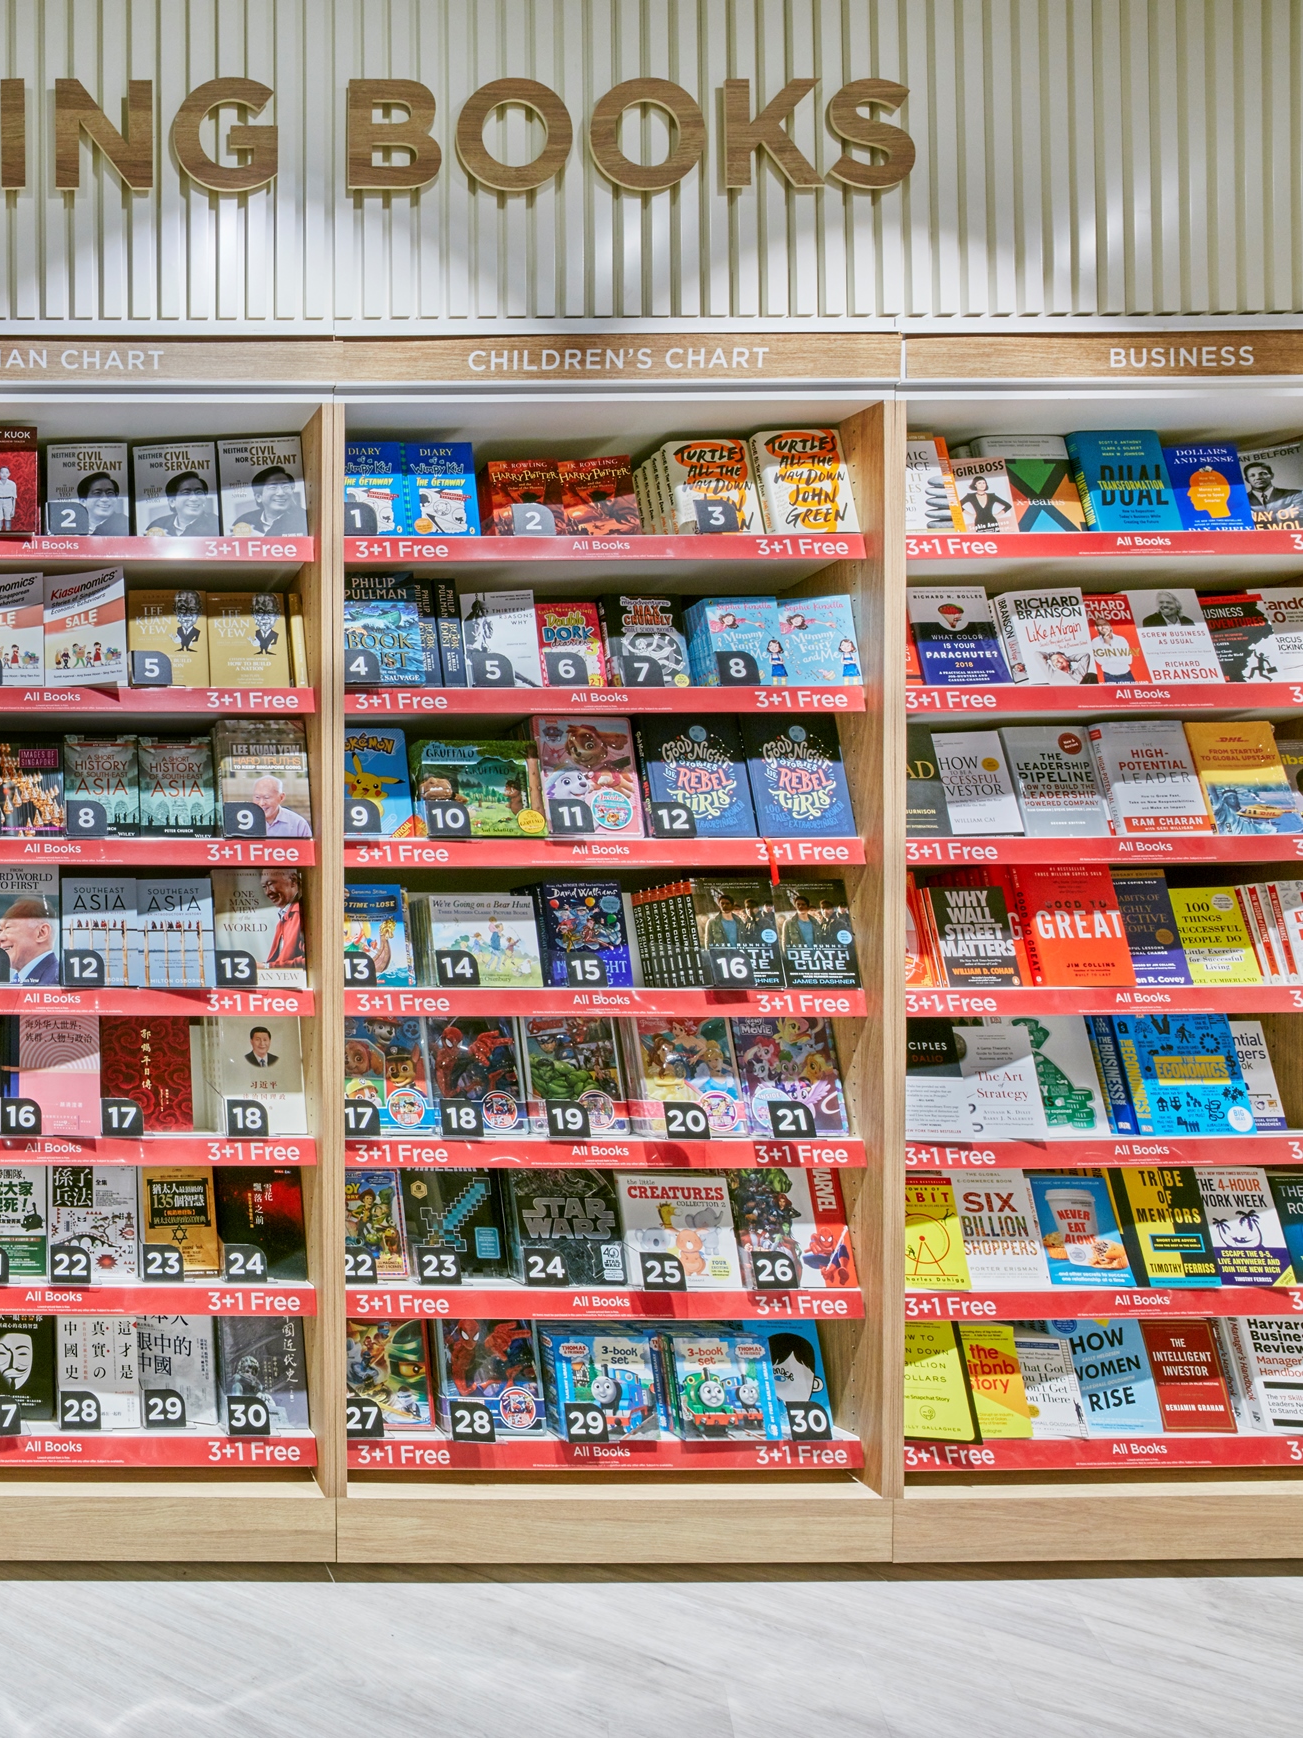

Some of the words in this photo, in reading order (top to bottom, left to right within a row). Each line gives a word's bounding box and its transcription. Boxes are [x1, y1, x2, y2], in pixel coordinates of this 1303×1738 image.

[347, 77, 916, 190] BOOKS
[61, 350, 165, 370] CHART
[468, 348, 652, 372] CHILDREN'S
[665, 347, 770, 369] CHART
[1110, 346, 1254, 368] BUSINESS
[764, 434, 836, 452] TURTLES
[138, 450, 162, 460] NEITHER
[163, 450, 190, 461] CIVIL
[419, 448, 453, 457] DIARY
[165, 460, 210, 471] SERVANT
[1098, 480, 1164, 490] TRANSFORMATION
[789, 483, 836, 505] JOHN
[61, 509, 76, 527] 2
[785, 503, 847, 524] GREEN
[906, 540, 946, 555] 3+1
[949, 538, 997, 554] Free
[1116, 537, 1131, 546] All
[1134, 536, 1171, 546] Books
[729, 658, 746, 677] 8
[75, 760, 127, 771] HISTORY
[1017, 762, 1090, 772] LEADERSHIP
[1119, 760, 1186, 770] POTENTIAL
[77, 777, 127, 795] ASIA
[238, 810, 253, 829] 9
[1163, 817, 1203, 826] CHARAN
[25, 844, 42, 853] All
[45, 843, 81, 854] Books
[944, 891, 987, 907] WHY
[947, 908, 994, 923] WALL
[944, 924, 1002, 940] STREET
[788, 949, 850, 960] DEATH
[940, 939, 1016, 956] MATTERS
[71, 958, 97, 977] 12
[796, 960, 847, 970] CURE
[1155, 1062, 1228, 1078] ECONOMICS
[977, 1087, 1028, 1101] Strategy
[668, 1110, 705, 1132] 20
[355, 1146, 391, 1162] 3+1
[398, 1146, 448, 1162] Free
[571, 1146, 589, 1156] All
[593, 1145, 629, 1156] Books
[628, 1185, 724, 1201] CREATURES
[1218, 1180, 1260, 1192] 4-HOUR
[523, 1197, 614, 1219] STAR
[964, 1192, 1017, 1213] SIX
[523, 1216, 616, 1241] WARS
[964, 1239, 1038, 1256] SHOPPERS
[1072, 1328, 1123, 1354] HOW
[601, 1347, 638, 1358] 3-book
[1153, 1351, 1212, 1363] INTELLIGENT
[1162, 1365, 1209, 1377] INVESTOR
[1088, 1387, 1136, 1412] RISE
[570, 1412, 603, 1433] 29
[905, 1448, 951, 1465] 3+1
[955, 1447, 995, 1464] Free
[1112, 1443, 1129, 1454] All
[1131, 1443, 1167, 1454] Books
